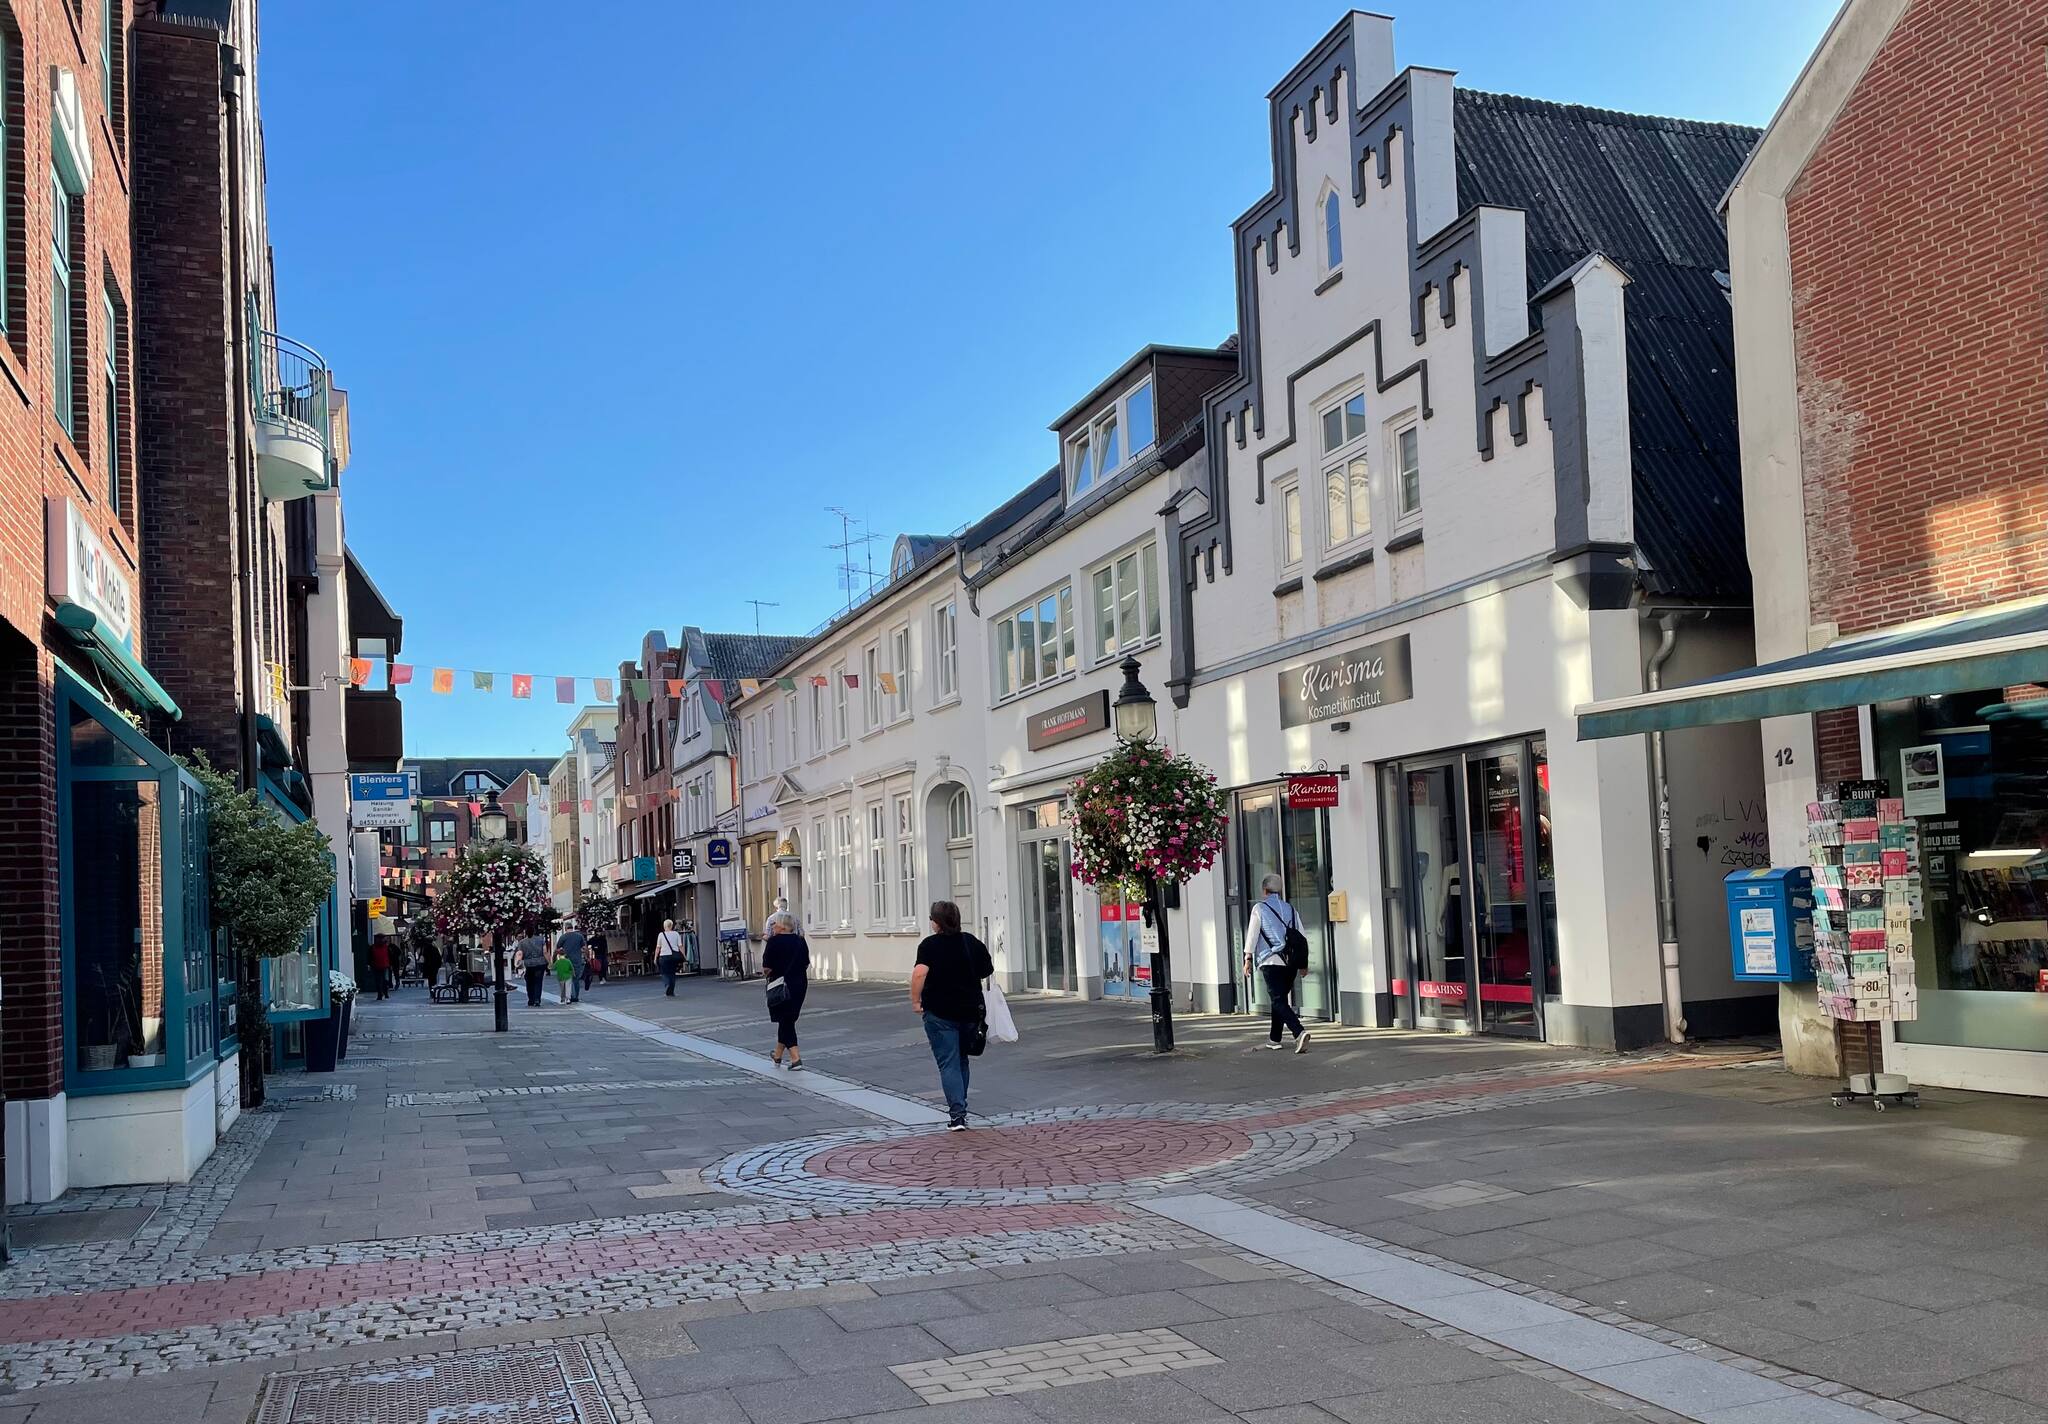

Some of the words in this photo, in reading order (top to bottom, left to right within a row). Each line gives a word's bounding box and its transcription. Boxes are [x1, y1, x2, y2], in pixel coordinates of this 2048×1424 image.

[74, 521, 94, 583] Your
[101, 560, 125, 624] Mobile
[1300, 656, 1385, 701] Karisma
[1308, 689, 1382, 720] Kosmetikinstitut
[1774, 747, 1794, 767] 12
[359, 776, 402, 784] Blenkers
[1289, 783, 1338, 797] Karisma
[1851, 789, 1877, 800] BUNT
[1886, 802, 1897, 814] 18
[1922, 836, 1941, 847] SOLD
[1942, 834, 1961, 845] HERE
[673, 855, 692, 867] BB
[1422, 983, 1464, 996] CLARINS
